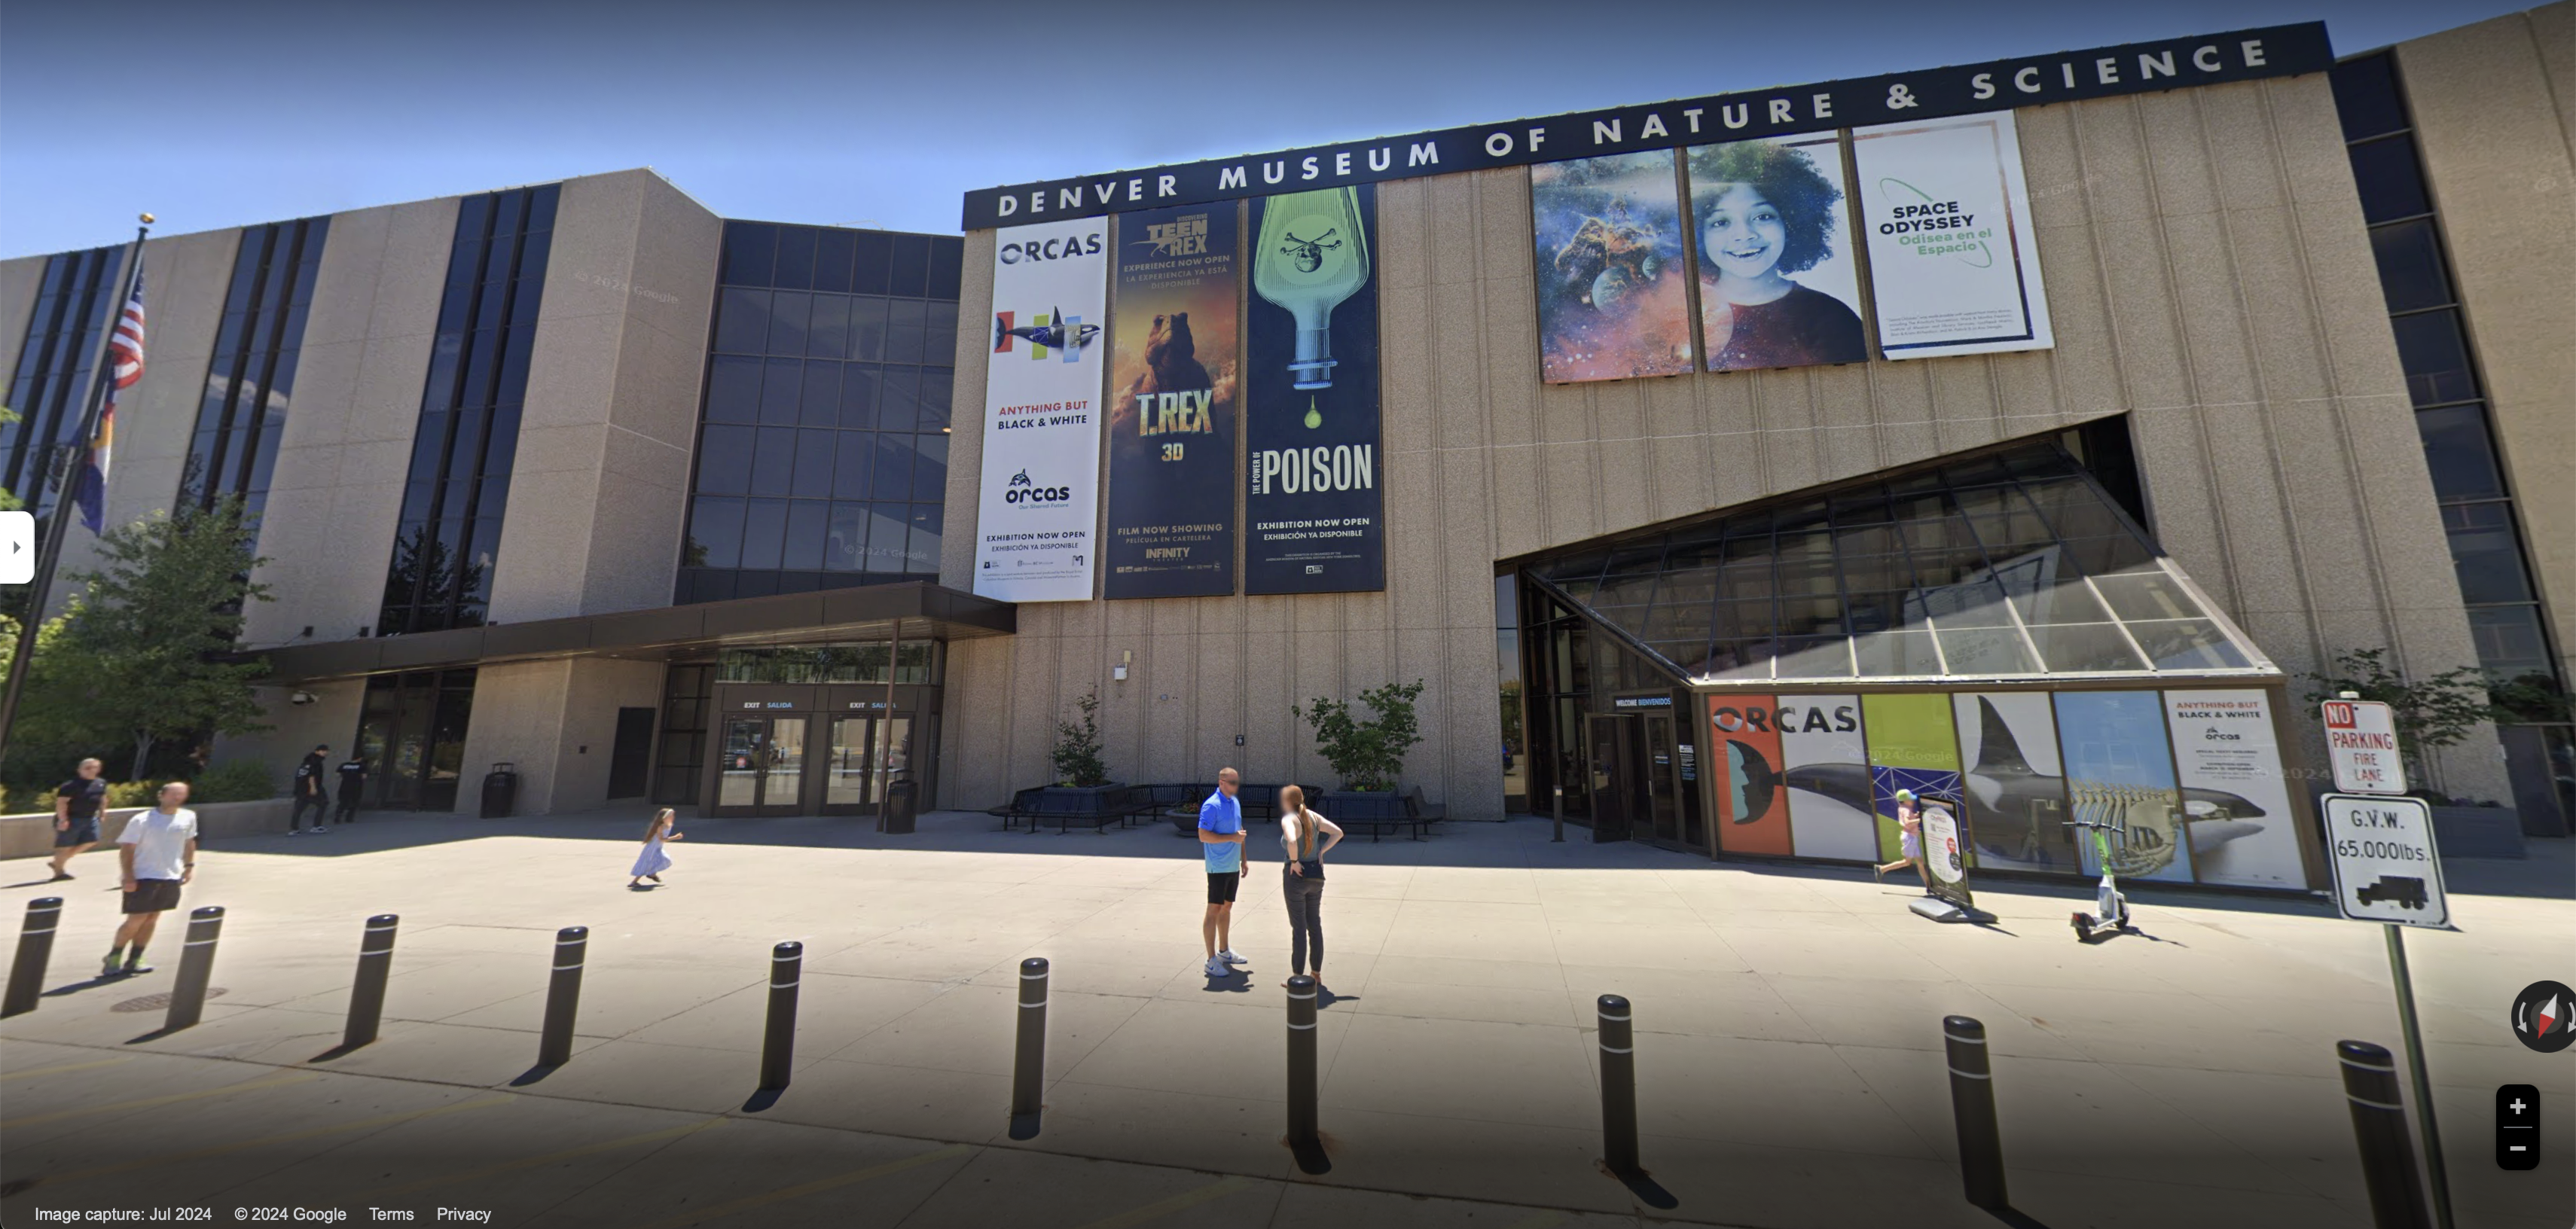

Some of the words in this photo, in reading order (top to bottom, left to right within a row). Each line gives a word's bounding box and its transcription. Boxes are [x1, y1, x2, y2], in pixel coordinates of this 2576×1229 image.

[998, 174, 1177, 217] DENVER
[1218, 141, 1439, 191] MUSEUM
[1485, 127, 1546, 157] OF
[1593, 93, 1833, 145] NATURE
[1885, 84, 1918, 111] &
[1972, 40, 2266, 100] SCIENCE
[1177, 213, 1207, 222] DISCOVERING
[1893, 201, 1958, 219] SPACE
[1146, 219, 1207, 240] TEEN
[1879, 215, 1974, 235] ODYSSEY
[1899, 233, 1952, 245] Odisea
[1957, 230, 1975, 240] en
[1979, 227, 1992, 239] el
[1000, 233, 1102, 265] ORCAS
[1170, 234, 1207, 257] REX
[1918, 242, 1976, 256] Espacio
[1124, 261, 1176, 273] EXPERIENCE
[1178, 258, 1202, 267] NOW
[1204, 255, 1230, 264] OPEN
[1139, 270, 1192, 282] EXPERIENCIA
[1207, 265, 1227, 274] ESTÁ
[1151, 278, 1201, 289] DISPONIBLE
[999, 402, 1061, 416] ANYTHING
[1065, 401, 1088, 411] BUT
[1135, 389, 1213, 437] T.REX
[998, 419, 1034, 430] BLACK
[1038, 418, 1046, 427] &
[1050, 415, 1087, 426] WHITE
[1161, 443, 1184, 462] 3D
[1252, 459, 1261, 483] POWER
[1262, 444, 1372, 495] POISON
[1006, 486, 1070, 503] orcas
[1252, 483, 1261, 495] THE
[1143, 526, 1169, 534] NOW
[1171, 523, 1223, 533] SHOWING
[1257, 520, 1312, 530] EXHIBITION
[1315, 519, 1340, 527] NOW
[1343, 517, 1369, 526] OPEN
[987, 532, 1034, 542] EXHIBITION
[1037, 532, 1059, 540] NOW
[1264, 531, 1307, 541] EXHIBICIÓN
[1319, 530, 1363, 538] DISPONIBLE
[992, 543, 1028, 552] EXHIBICIÓN
[1146, 547, 1190, 559] INFINITY
[1637, 697, 1671, 706] BIENVENIDOS
[1713, 706, 1857, 733] ORCAS
[2327, 705, 2351, 724] NO
[2332, 732, 2394, 750] PARKING
[2354, 753, 2378, 766] FIRE
[2355, 768, 2385, 782] LANE
[2351, 810, 2405, 830] G.V.W.
